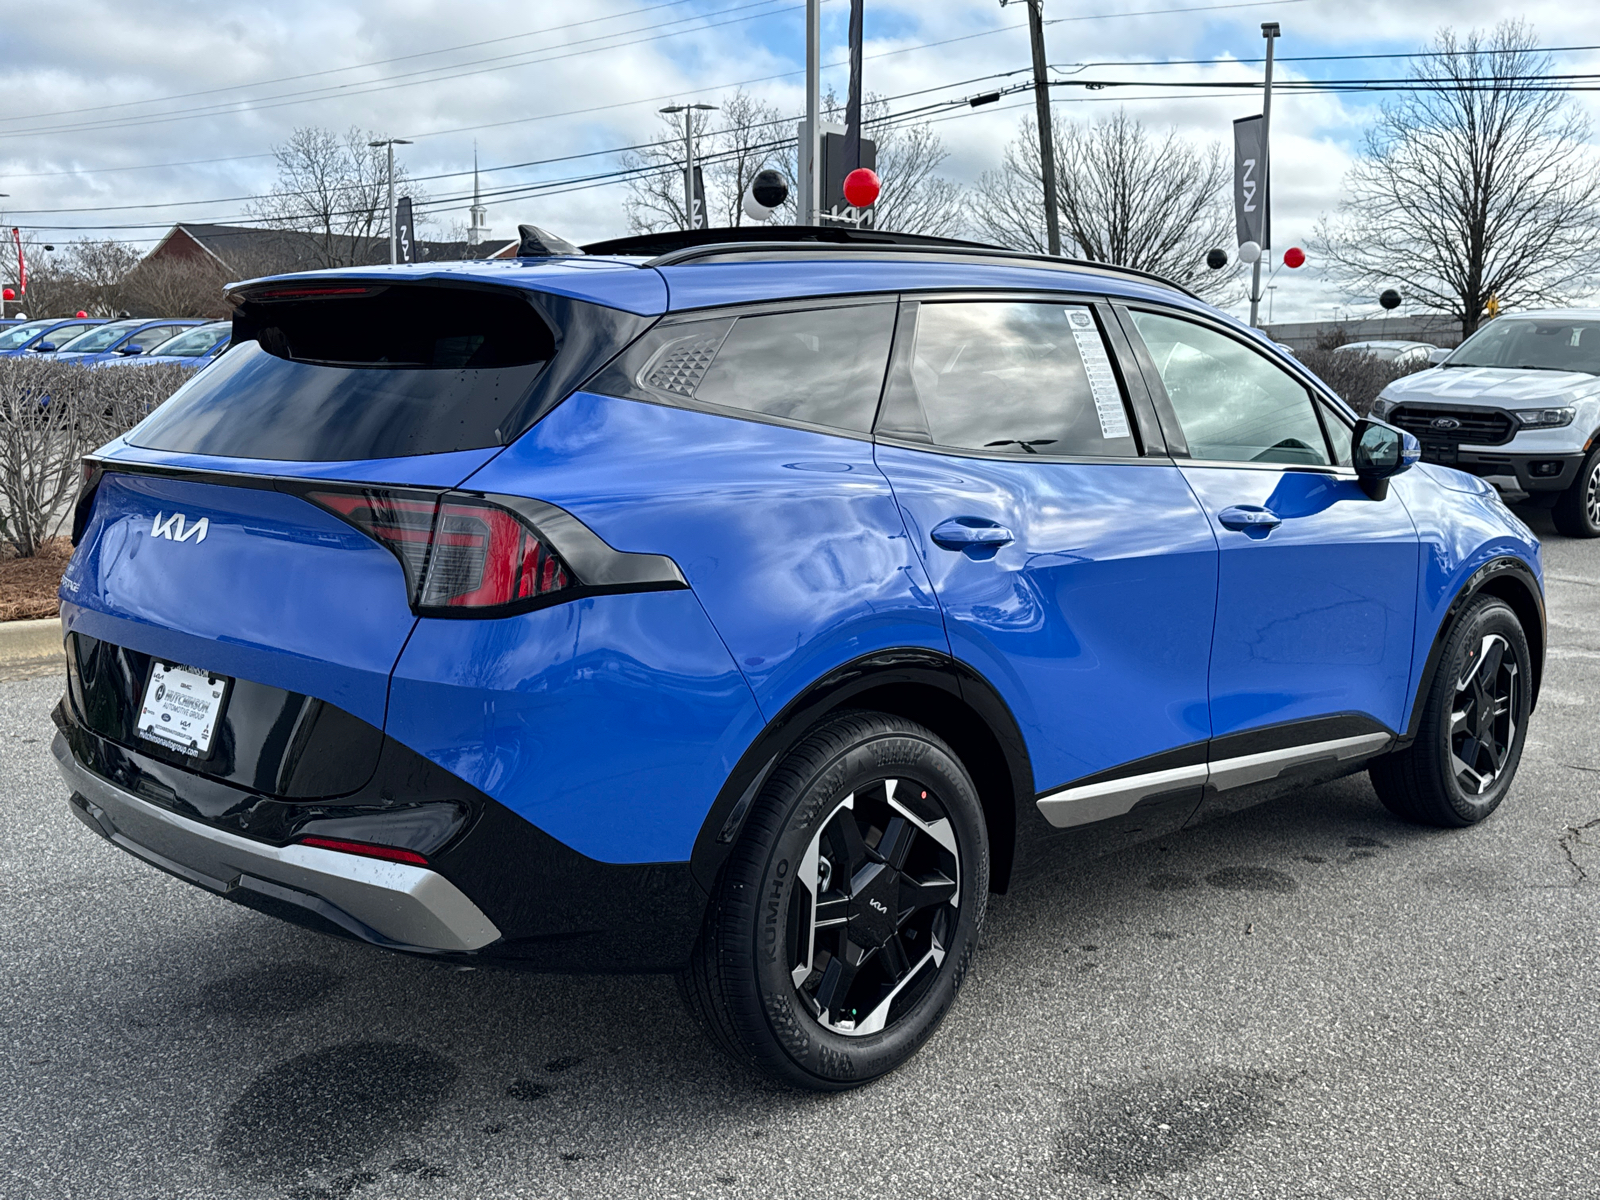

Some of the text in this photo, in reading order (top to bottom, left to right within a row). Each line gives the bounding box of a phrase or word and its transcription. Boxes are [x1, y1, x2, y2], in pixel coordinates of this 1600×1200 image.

[1243, 159, 1256, 212] KIA
[831, 204, 873, 226] KIA
[400, 225, 409, 261] KIA
[150, 510, 209, 545] KIA
[163, 702, 190, 717] AUTOMOTIVE
[189, 710, 205, 720] GROUP
[764, 858, 789, 966] KUMHO
[870, 898, 887, 914] KIA
